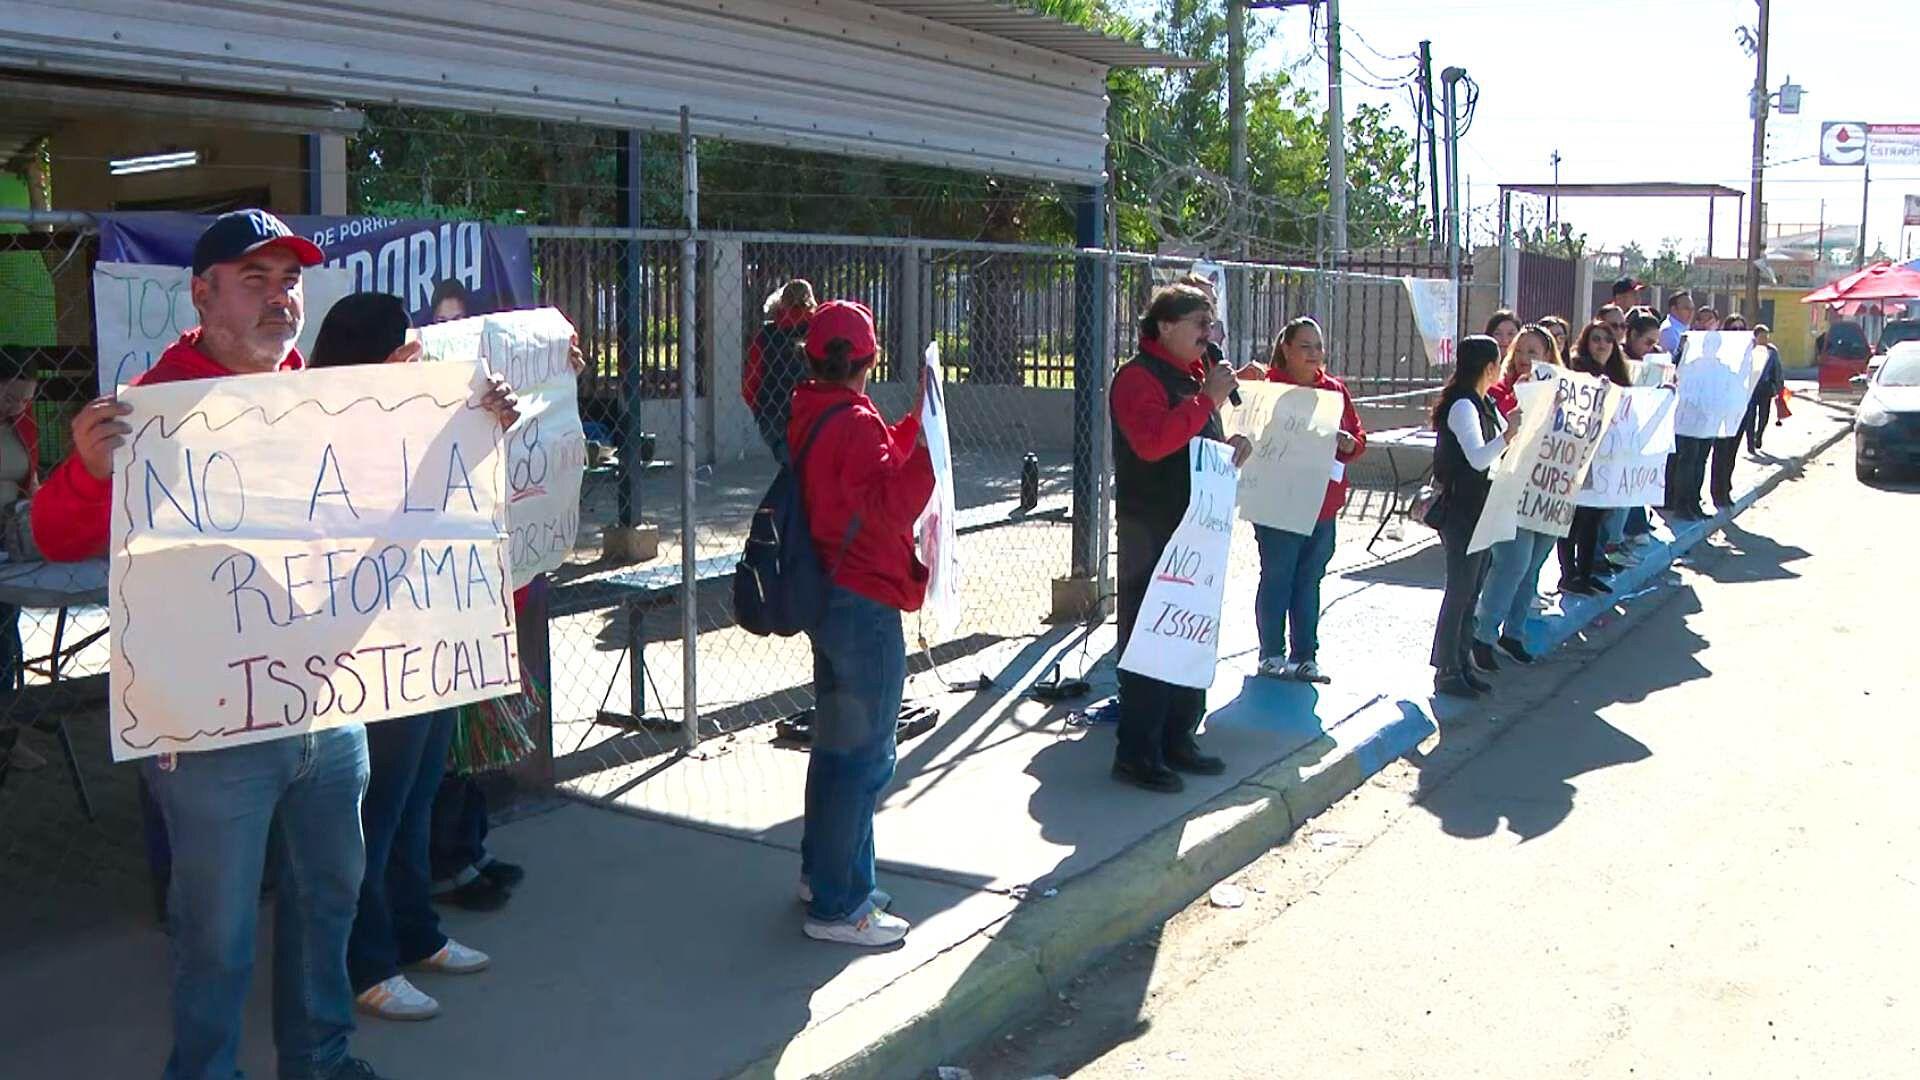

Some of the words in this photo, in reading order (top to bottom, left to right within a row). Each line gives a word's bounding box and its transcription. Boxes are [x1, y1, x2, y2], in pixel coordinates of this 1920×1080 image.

[314, 227, 336, 248] DE
[144, 448, 245, 533] NO
[309, 443, 360, 521] A
[403, 438, 479, 512] LA
[508, 417, 547, 492] 68
[211, 543, 497, 633] REFORMA
[1164, 545, 1201, 579] NO
[223, 631, 520, 736] ISSSTECALI
